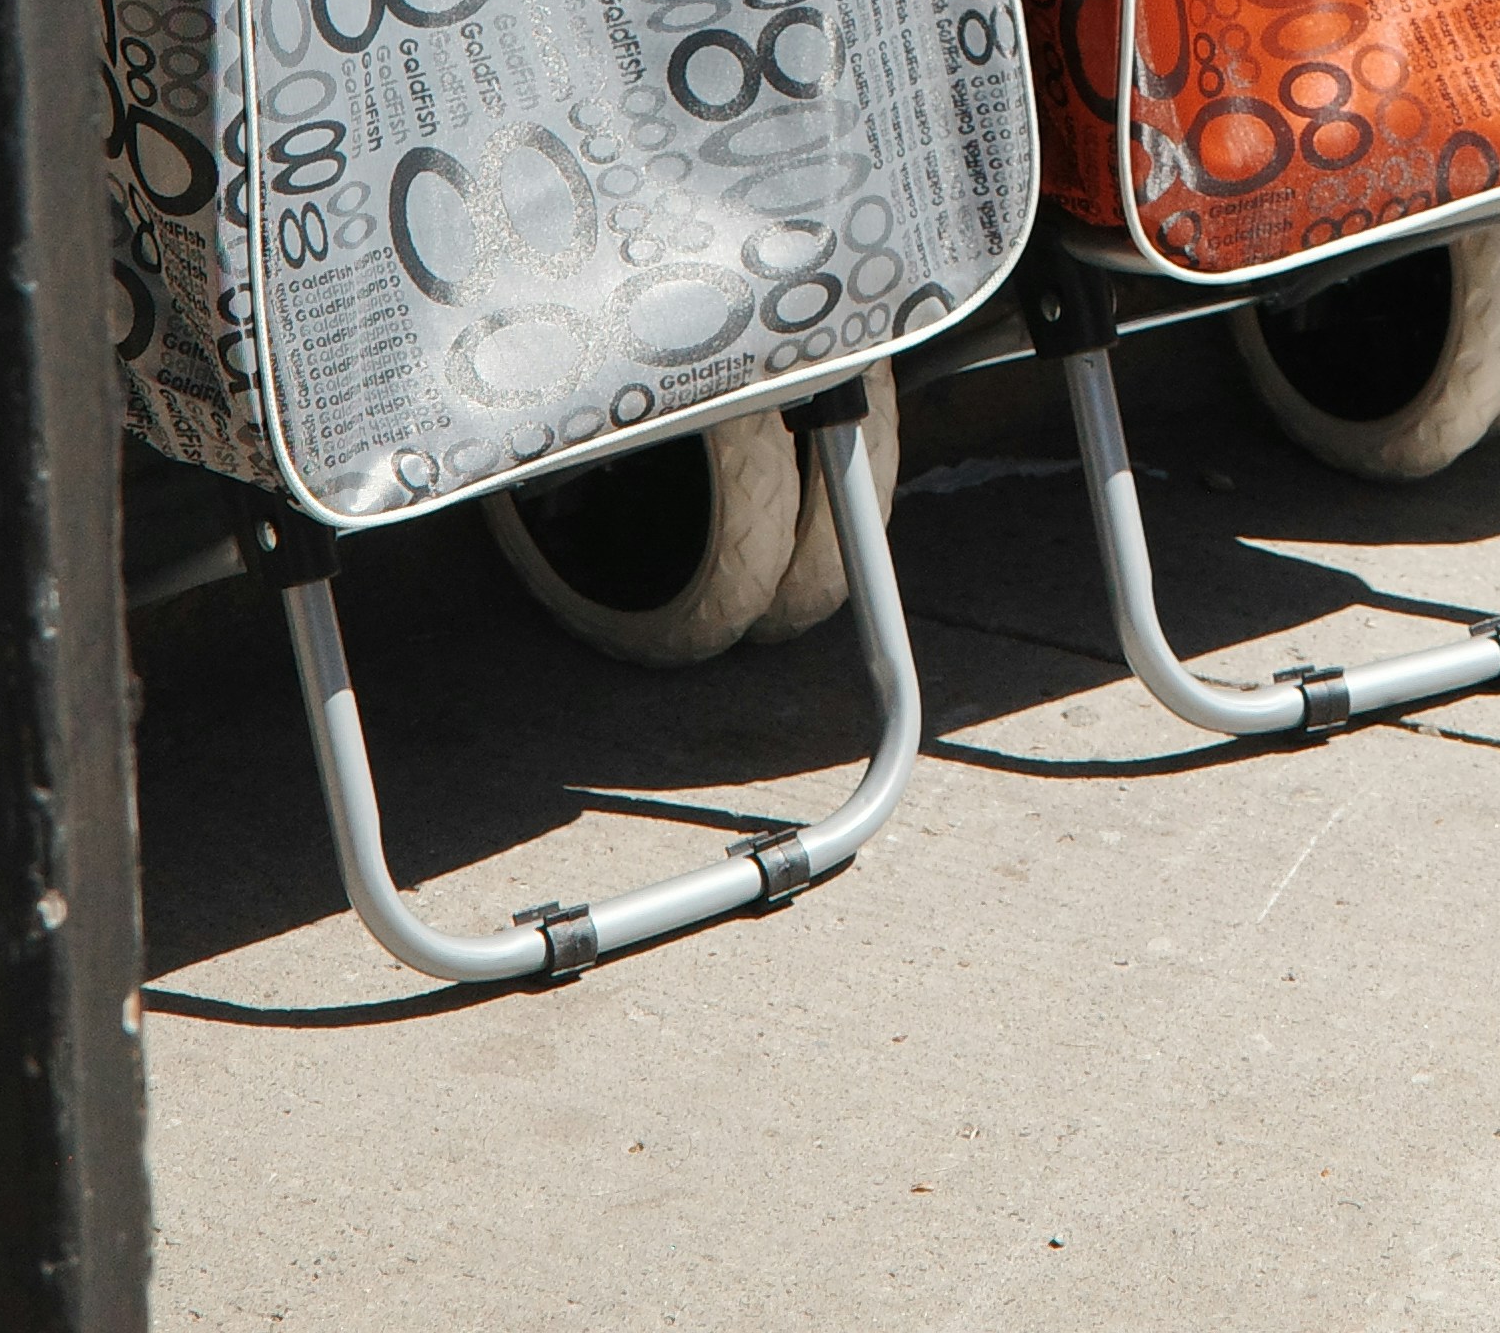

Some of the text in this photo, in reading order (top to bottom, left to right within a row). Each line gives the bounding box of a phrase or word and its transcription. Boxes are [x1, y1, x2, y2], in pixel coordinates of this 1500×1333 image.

[361, 52, 383, 153] GoldFish
[400, 38, 440, 138] GoldFish
[660, 352, 755, 390] GoldFish
